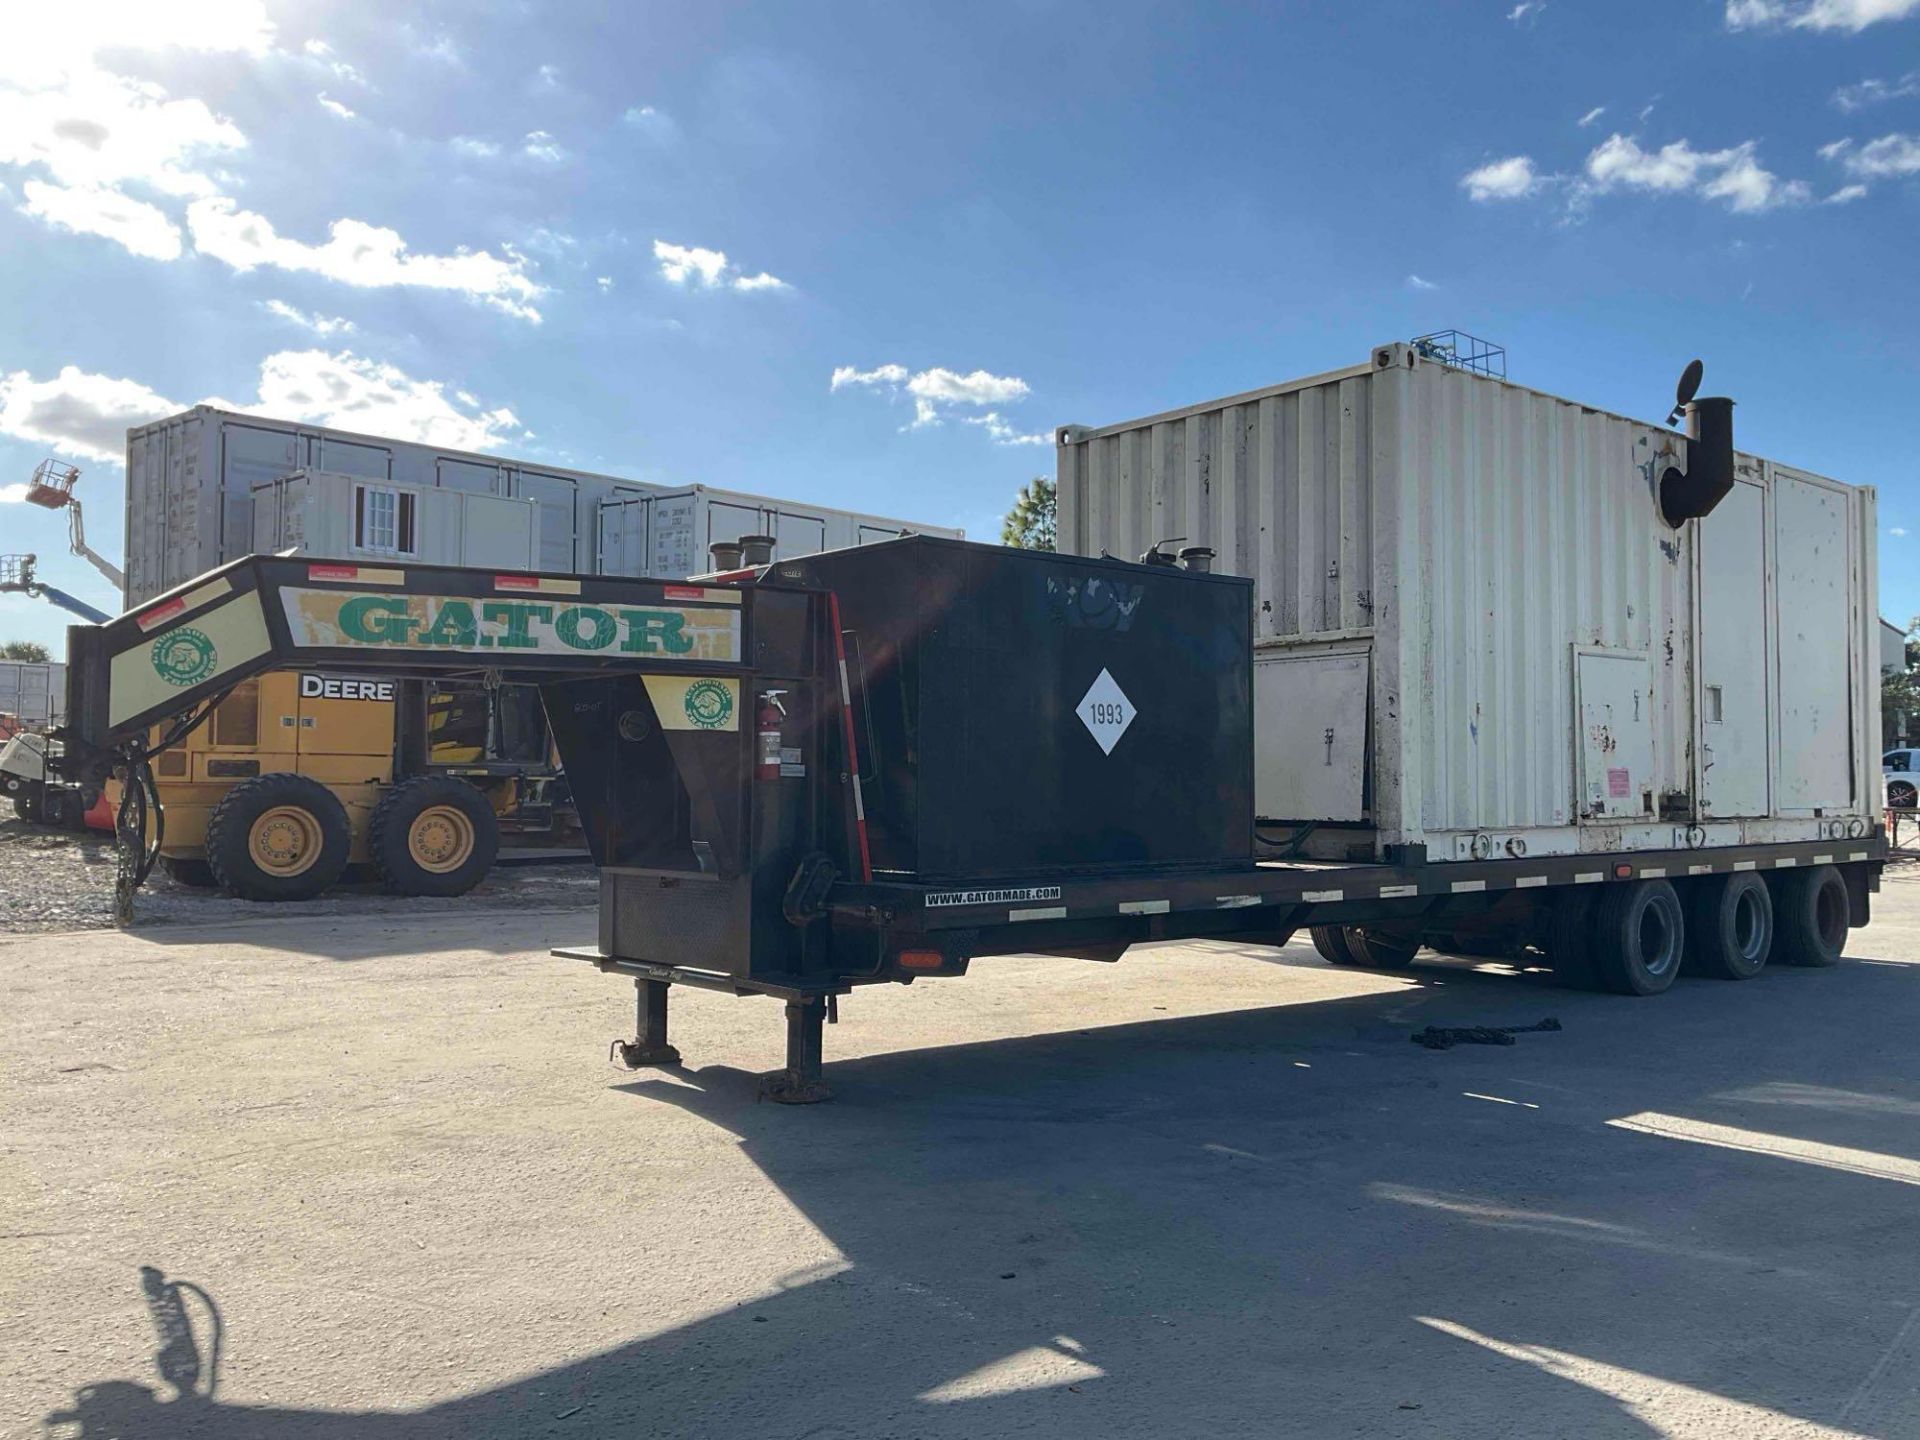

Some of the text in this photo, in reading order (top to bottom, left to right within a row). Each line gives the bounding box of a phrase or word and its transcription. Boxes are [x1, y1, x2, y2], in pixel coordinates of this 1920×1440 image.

[338, 596, 694, 655] GATOR
[302, 675, 393, 700] DEERE
[1090, 703, 1123, 725] 1993
[927, 888, 1060, 905] WWW.GATORMADE.COM
